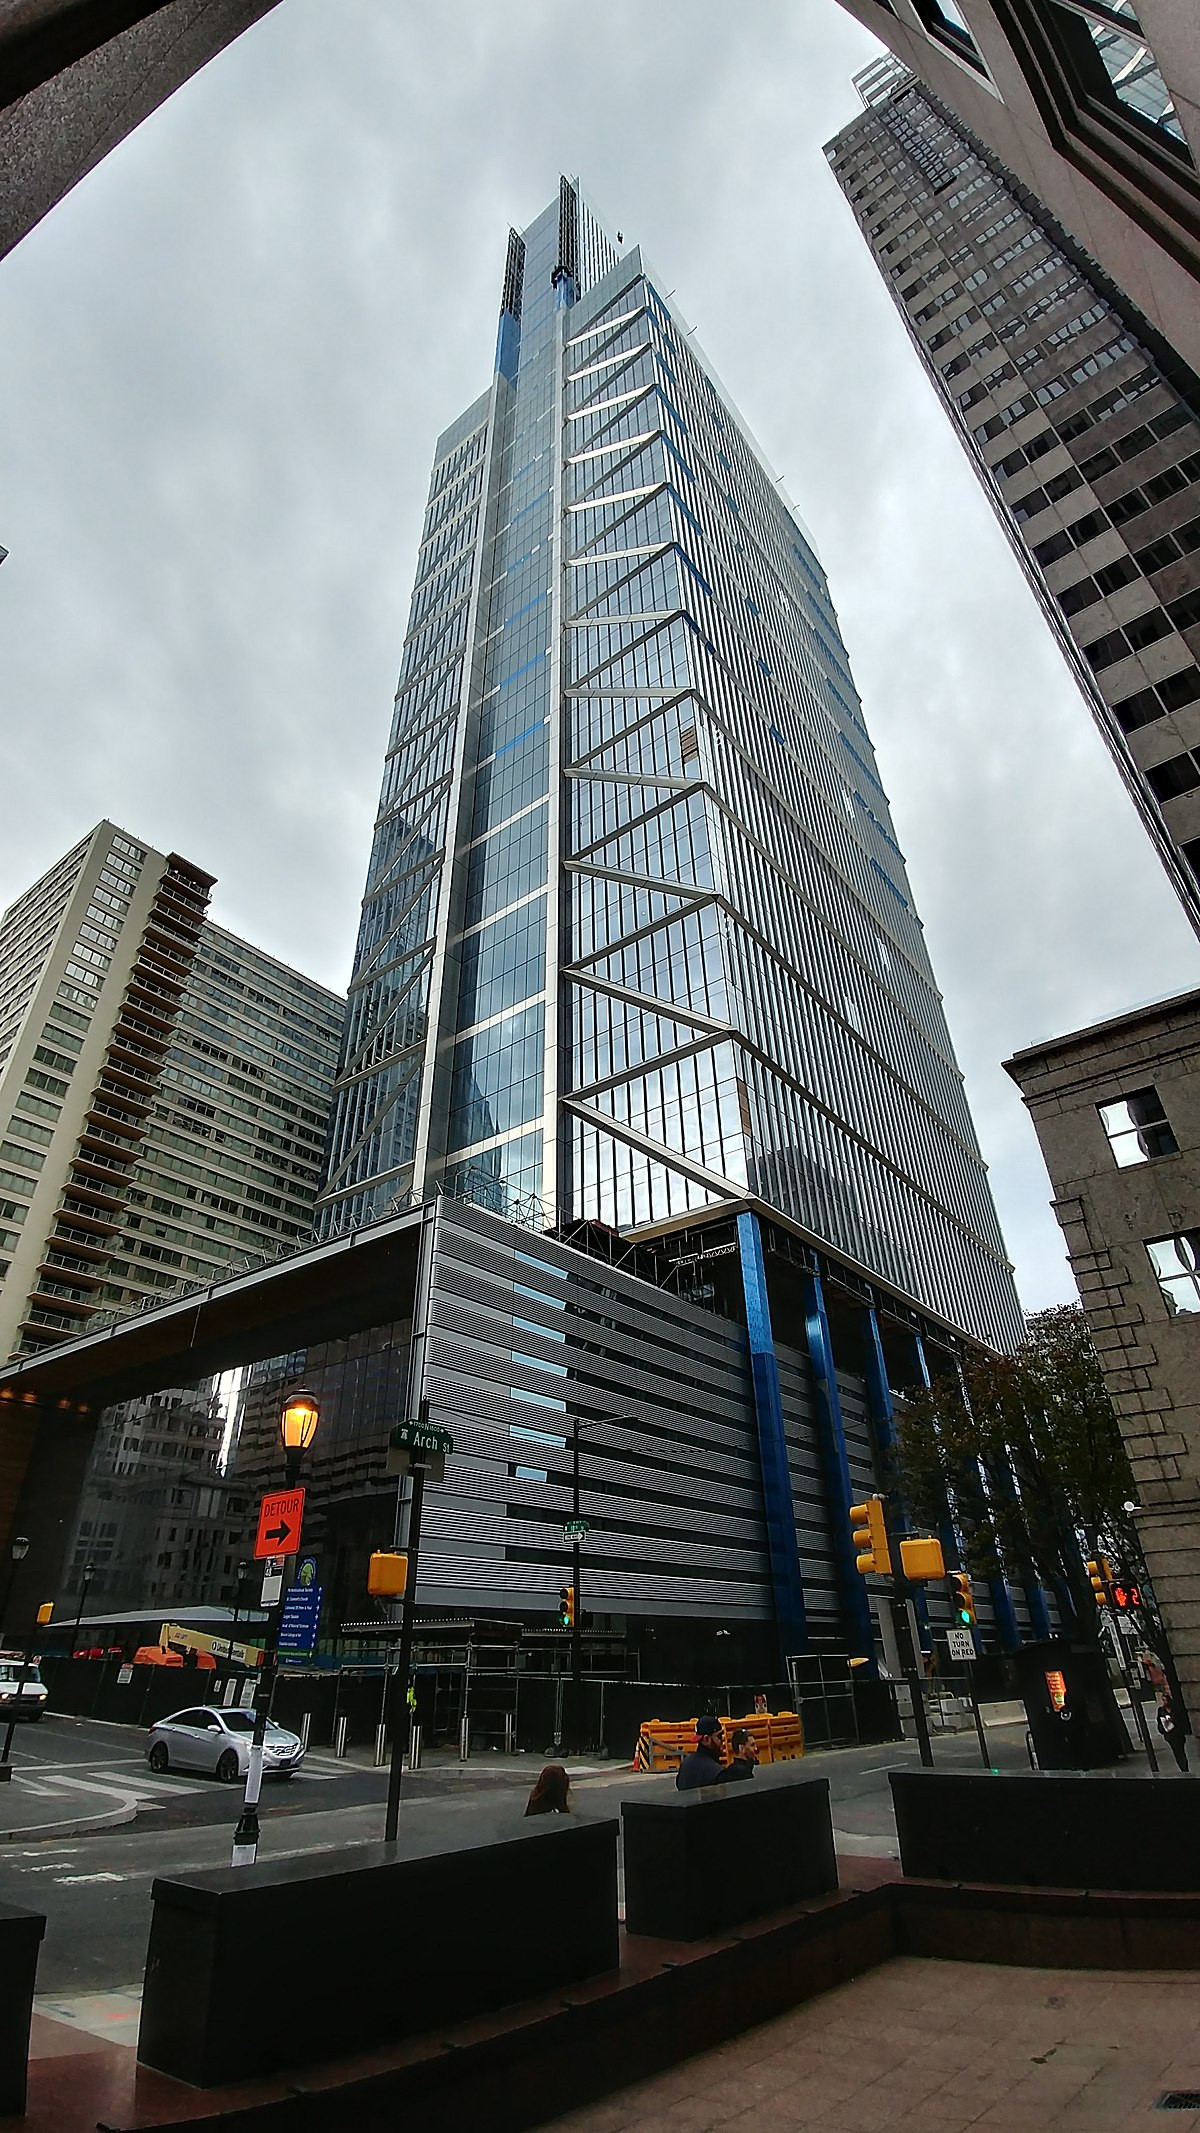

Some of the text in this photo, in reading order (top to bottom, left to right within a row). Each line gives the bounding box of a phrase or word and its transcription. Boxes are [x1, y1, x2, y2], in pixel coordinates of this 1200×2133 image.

[413, 1431, 450, 1453] Arch St
[264, 1498, 300, 1518] DETOUR
[1130, 1588, 1140, 1605] 2
[954, 1632, 964, 1640] NO
[952, 1640, 970, 1648] TURN
[951, 1648, 974, 1658] ON RED
